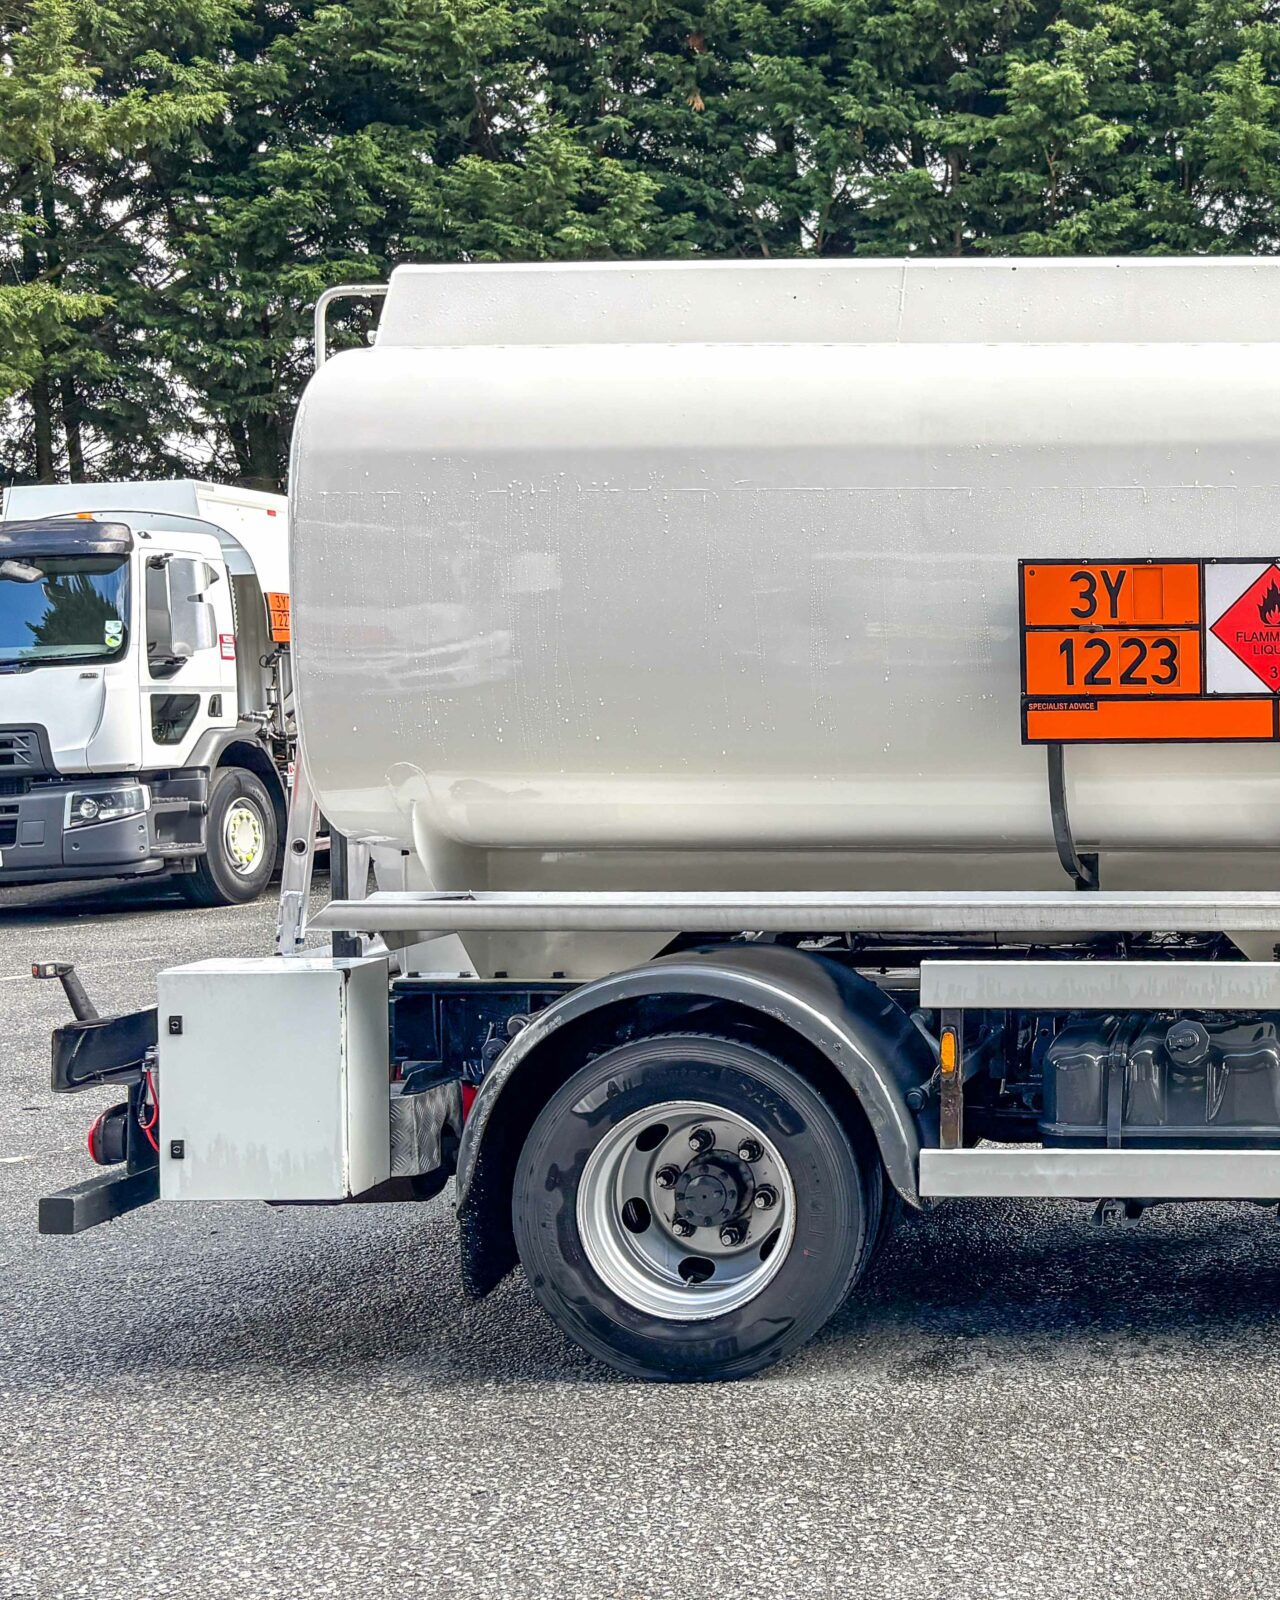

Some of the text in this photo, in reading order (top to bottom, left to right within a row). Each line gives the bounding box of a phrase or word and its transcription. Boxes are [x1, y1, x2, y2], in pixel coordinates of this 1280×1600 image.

[1070, 570, 1126, 618] 3Y
[275, 595, 290, 609] 3Y
[273, 612, 290, 627] 122
[1059, 637, 1178, 685] 1223
[1270, 666, 1278, 679] 3
[1028, 702, 1095, 710] SPECIALIST ADVICE
